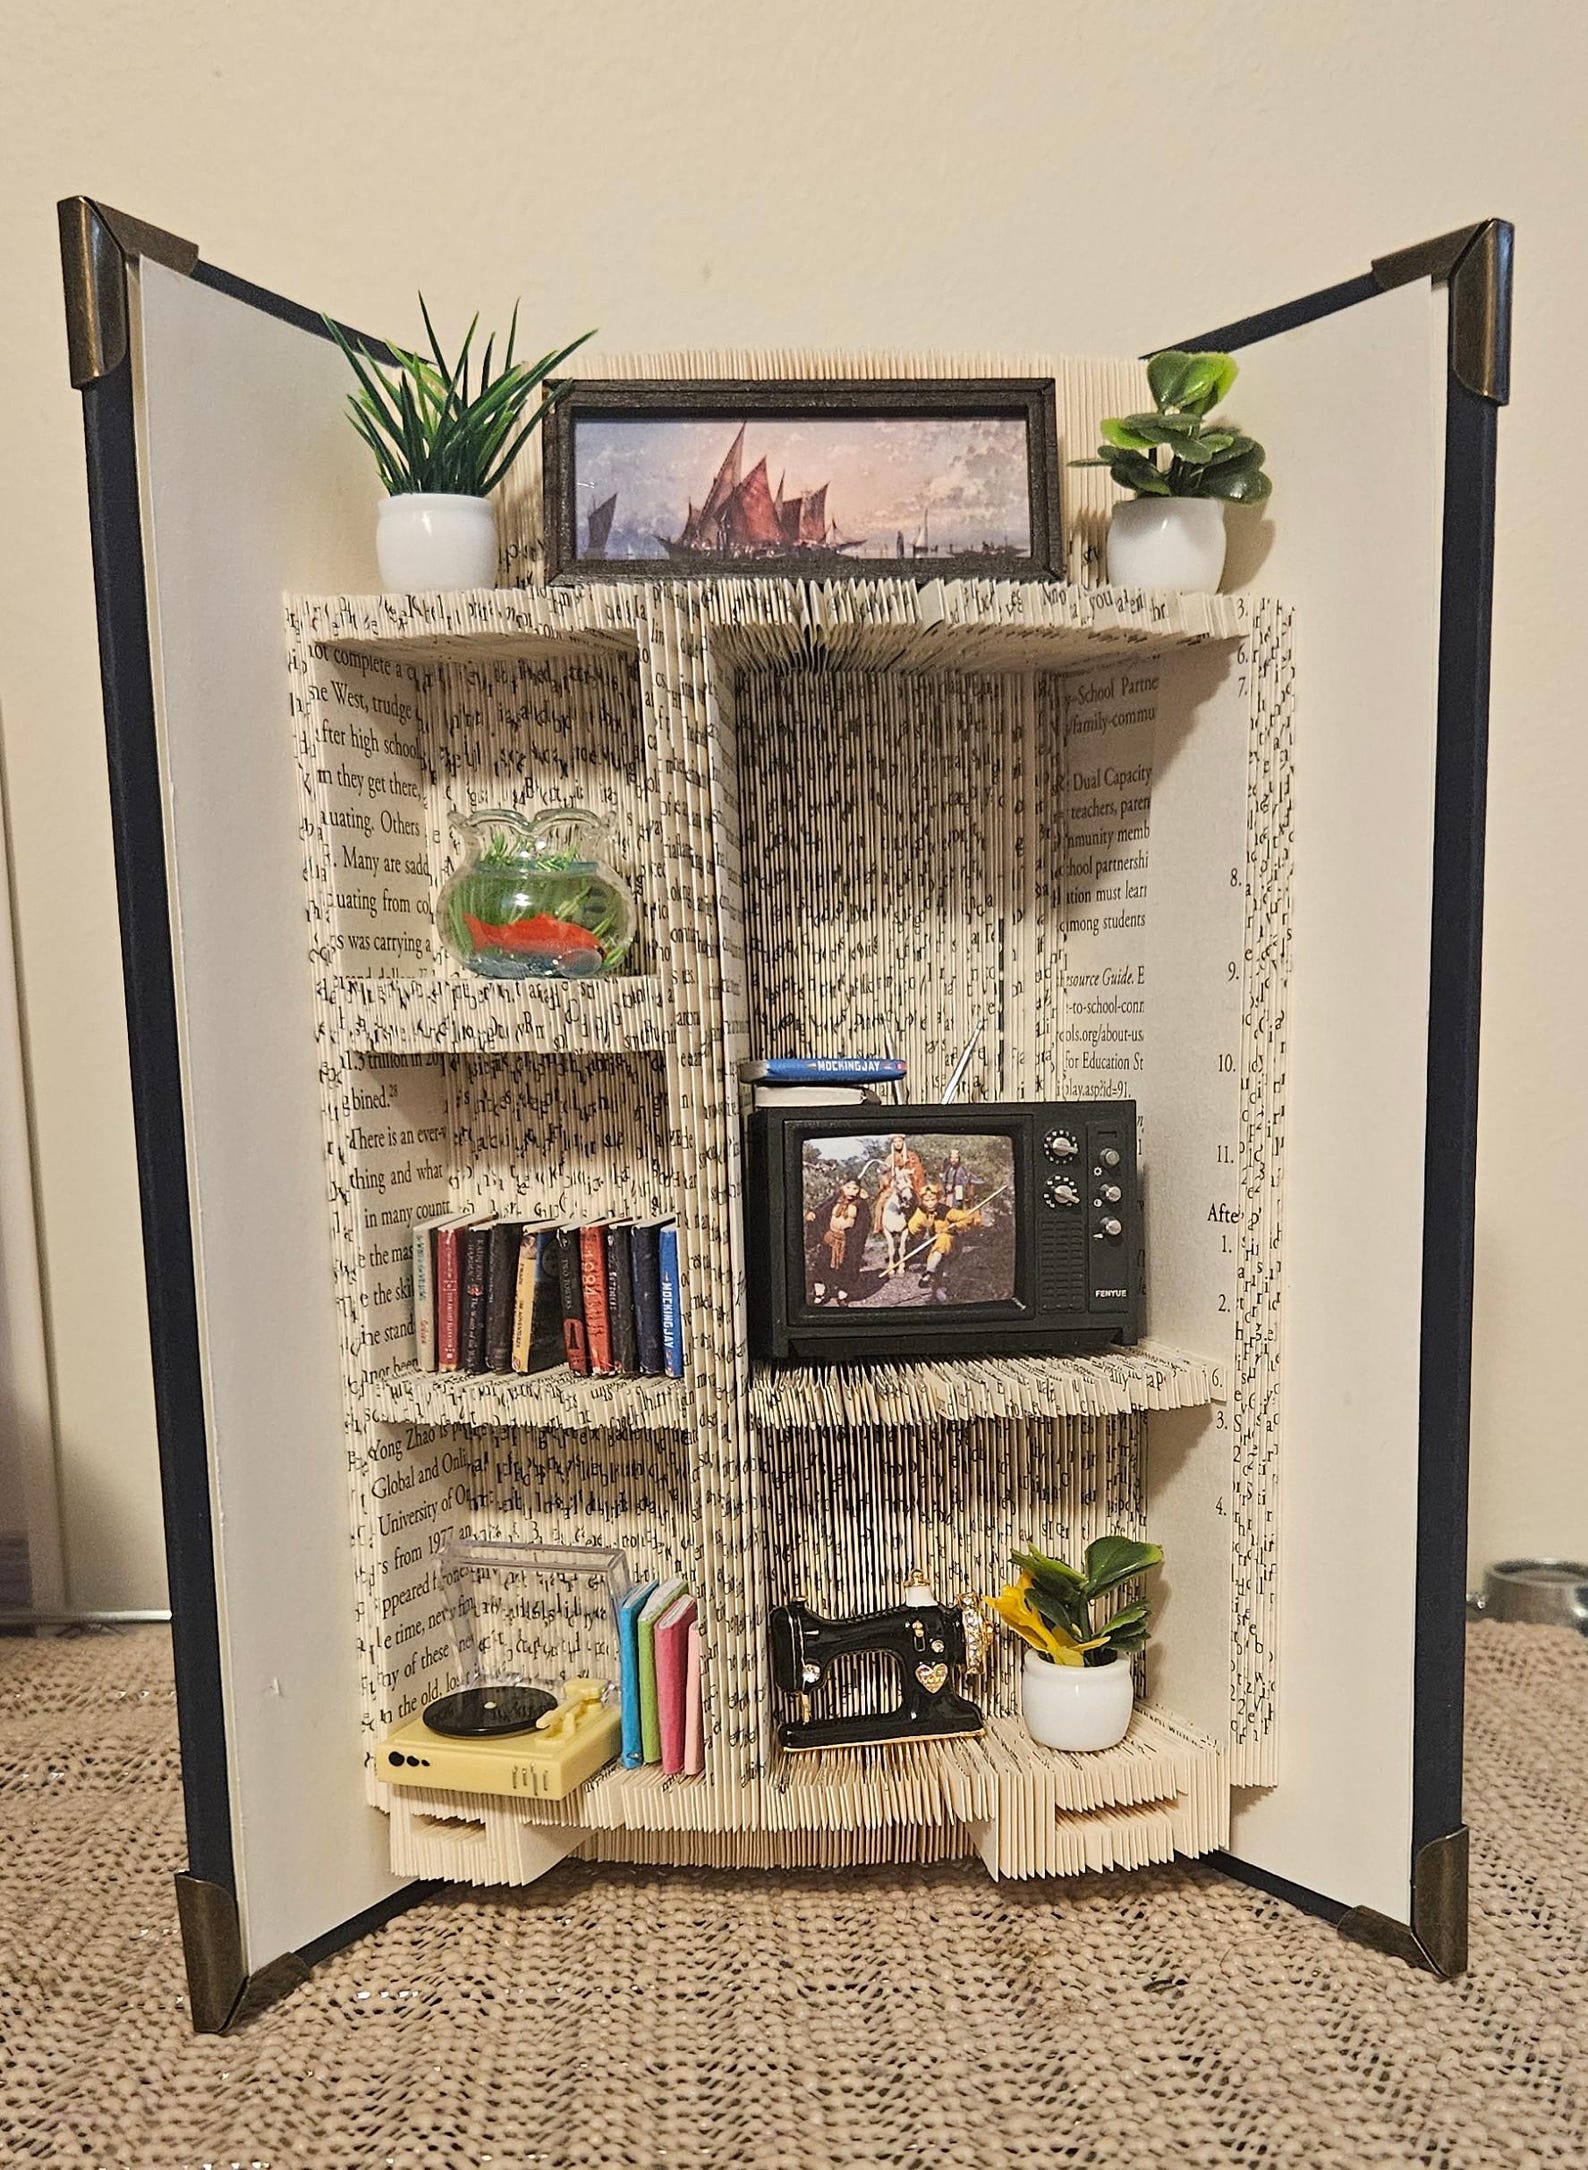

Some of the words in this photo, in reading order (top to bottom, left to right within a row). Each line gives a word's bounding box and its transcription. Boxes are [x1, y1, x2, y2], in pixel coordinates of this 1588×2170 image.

[333, 646, 391, 678] complete
[331, 680, 369, 713] West,
[372, 694, 412, 725] trudge
[350, 724, 379, 758] high
[337, 763, 364, 796] they
[368, 776, 386, 798] get
[390, 772, 421, 800] there,
[1073, 769, 1101, 791] Dual
[1104, 764, 1152, 791] Capacity
[1071, 798, 1118, 820] teachers,
[380, 810, 420, 837] Others
[1117, 820, 1150, 843] memb
[342, 845, 379, 878] Many
[384, 857, 401, 873] are
[1095, 849, 1148, 880] partnershi
[1230, 867, 1242, 888] 8.
[383, 889, 411, 913] from
[1096, 886, 1122, 902] must
[1102, 909, 1146, 929] students
[348, 934, 370, 951] was
[374, 931, 422, 959] carrying
[1102, 964, 1135, 986] Guide.
[1228, 961, 1239, 981] 9.
[817, 1060, 880, 1072] MOCKINGJAY
[1082, 1051, 1130, 1071] Education
[1218, 1053, 1236, 1073] 10.
[388, 1126, 397, 1147] is
[400, 1132, 414, 1146] an
[350, 1167, 386, 1195] thing
[391, 1160, 412, 1185] and
[364, 1208, 377, 1229] in
[381, 1207, 413, 1229] many
[370, 1244, 389, 1267] the
[373, 1283, 392, 1306] the
[1218, 1294, 1231, 1313] 2.
[660, 1282, 675, 1348] MOCKINGJAY
[384, 1313, 415, 1342] stand
[406, 1426, 436, 1451] Zhao
[372, 1466, 415, 1499] Global
[418, 1457, 439, 1484] and
[379, 1500, 438, 1536] University
[441, 1487, 453, 1512] of
[1216, 1496, 1227, 1516] 4.
[394, 1546, 422, 1570] from
[395, 1620, 425, 1645] time,
[404, 1651, 418, 1678] of
[421, 1643, 449, 1669] these
[398, 1694, 417, 1718] the
